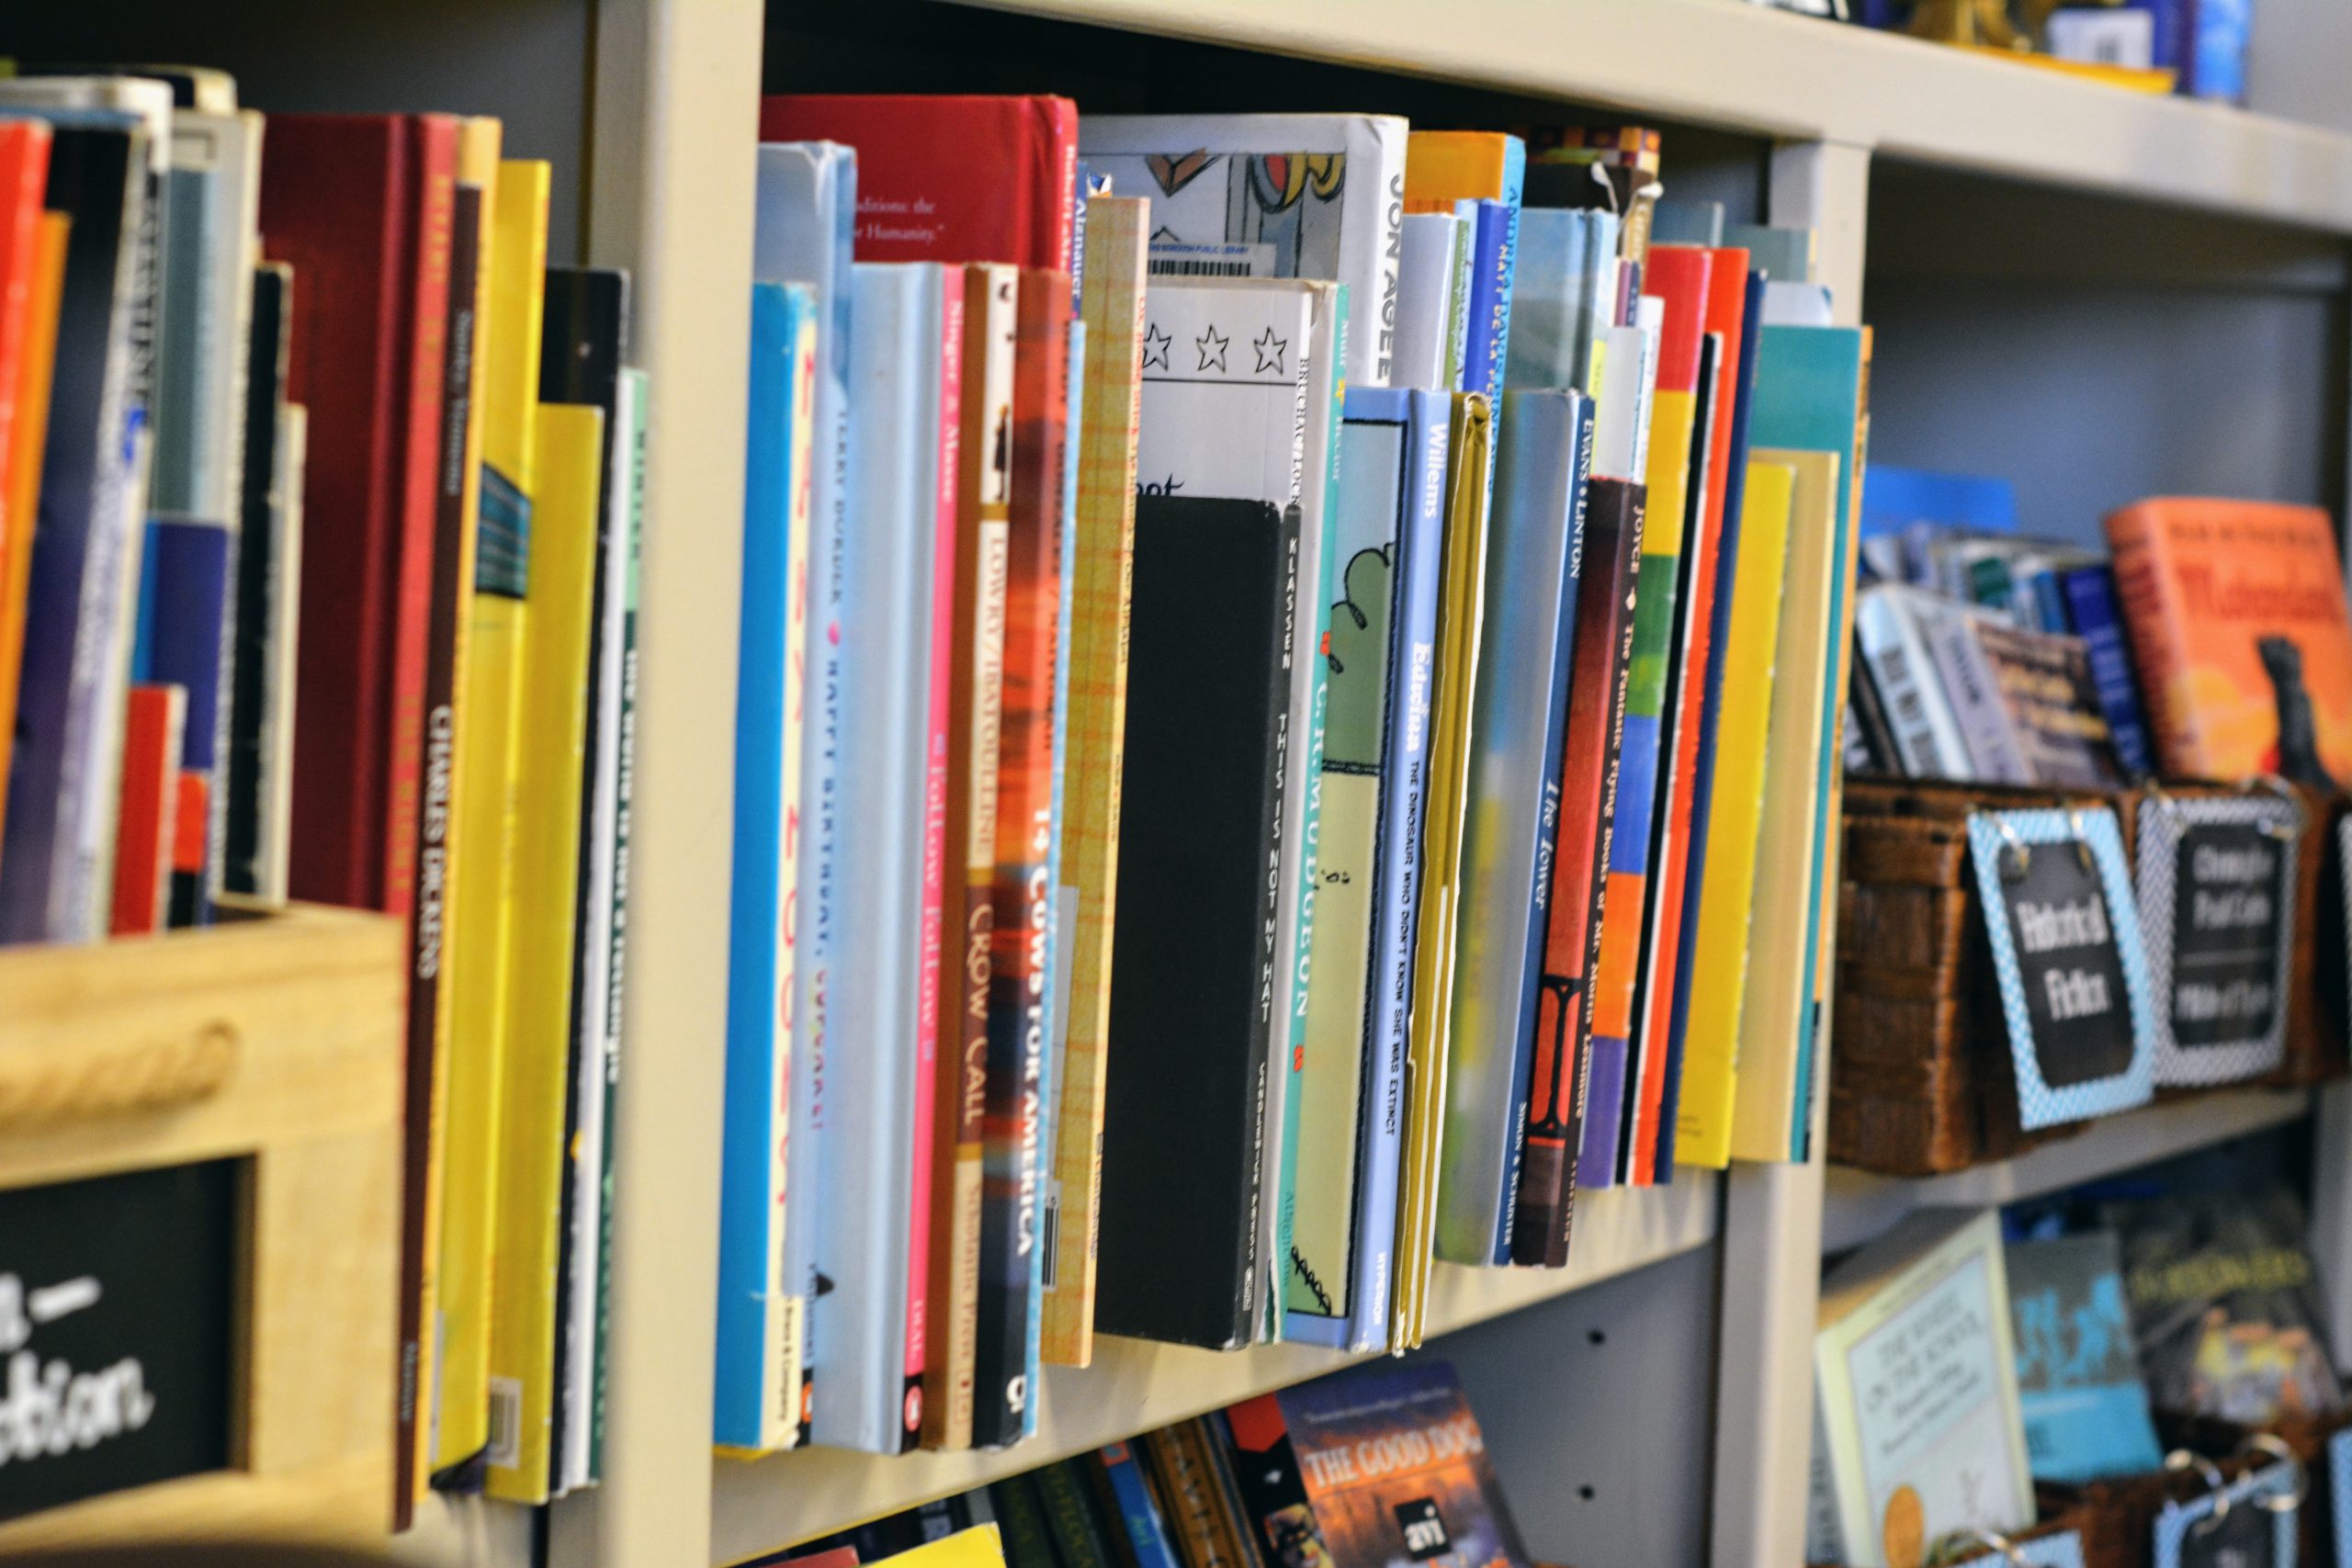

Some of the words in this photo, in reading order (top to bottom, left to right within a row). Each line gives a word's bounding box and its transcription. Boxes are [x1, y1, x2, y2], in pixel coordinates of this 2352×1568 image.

[1070, 197, 1087, 299] Alznauer
[1385, 173, 1405, 260] JON
[1500, 186, 1520, 291] ANDREA
[1495, 243, 1509, 293] MATT
[944, 298, 964, 383] Singer
[1338, 319, 1349, 368] Muir
[1376, 269, 1398, 380] AGEE
[1488, 337, 1499, 360] LA
[1491, 303, 1503, 330] DE
[1494, 299, 1510, 375] DAVIS
[1330, 415, 1343, 481] Hector
[1423, 422, 1447, 519] Willems
[1577, 418, 1595, 481] EVANS
[1567, 499, 1587, 579] LINTON
[1627, 505, 1645, 573] JOYCE
[1282, 537, 1297, 670] KLASSEN
[1621, 623, 1634, 660] The
[1406, 642, 1433, 751] Edwina
[1612, 668, 1629, 750] Fantastic
[422, 705, 454, 843] CHARLES
[1273, 713, 1288, 789] THIS
[1408, 759, 1420, 786] THE
[1271, 798, 1283, 839] IS
[1541, 778, 1560, 827] The
[1603, 758, 1621, 818] Flying
[1031, 807, 1050, 852] 14
[1403, 792, 1419, 865] DINOSAUR
[1599, 827, 1613, 883] Books
[1265, 848, 1280, 908] NOT
[1401, 870, 1414, 904] WHO
[1533, 837, 1555, 909] Tower
[1597, 890, 1606, 910] of
[413, 846, 445, 981] DICKENS
[1262, 917, 1275, 954] MY
[1397, 910, 1411, 955] DIDN'T
[1591, 919, 1602, 953] Mr.
[966, 903, 992, 1021] CROW
[1258, 962, 1272, 1022] HAT
[1394, 961, 1408, 1001] KNOW
[1584, 962, 1599, 1024] Morris
[1392, 1008, 1404, 1036] SHE
[963, 1037, 987, 1125] CALL
[1388, 1043, 1401, 1074] WAS
[1574, 1032, 1591, 1119] Lessmore
[1251, 1061, 1265, 1185] CANDLEWICK
[1385, 1078, 1399, 1135] EXTINCT
[1512, 1101, 1528, 1152] SIMON
[1016, 1089, 1038, 1257] AMERICA
[1247, 1192, 1259, 1260] PRESS
[1502, 1171, 1520, 1246] SCHUSTER
[1372, 1251, 1387, 1325] HYPERION
[0, 1349, 154, 1466] tion
[777, 1359, 792, 1422] Company
[1304, 1445, 1358, 1489] THE
[1357, 1428, 1430, 1477] GOOD
[1427, 1417, 1484, 1461] DOG
[1405, 1504, 1446, 1552] avi
